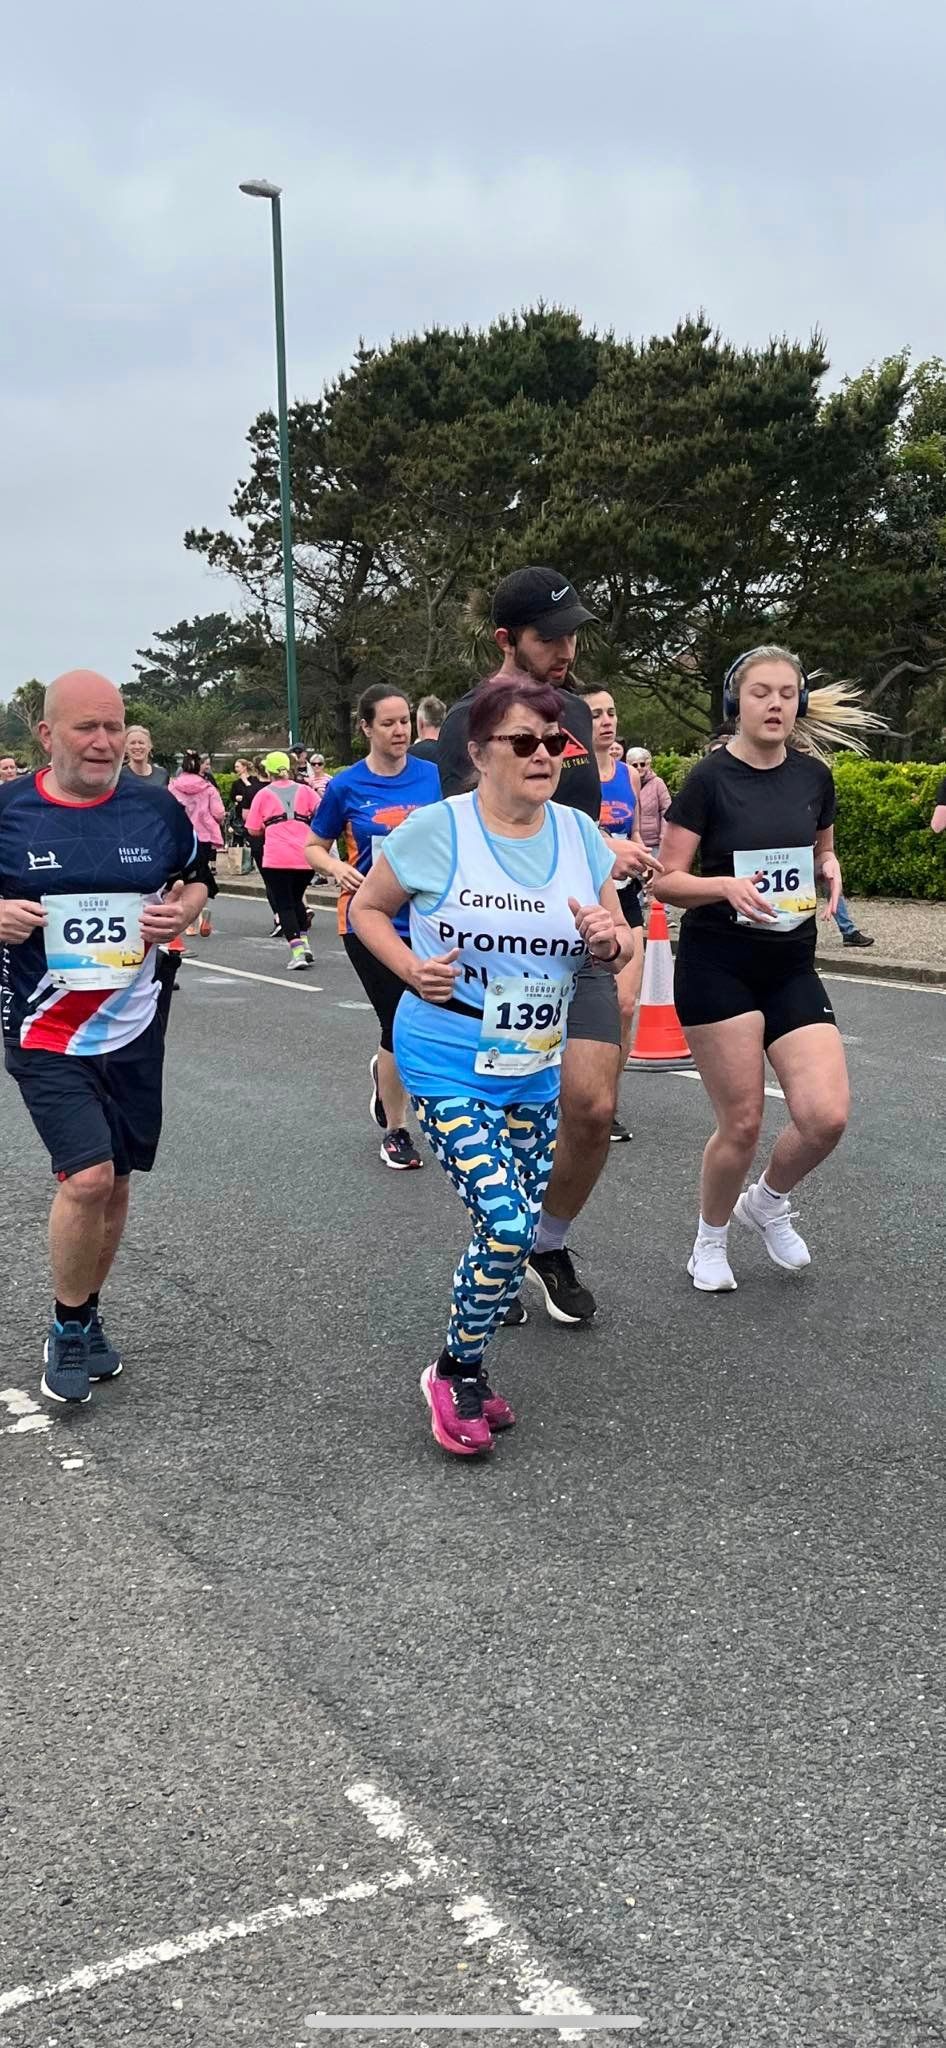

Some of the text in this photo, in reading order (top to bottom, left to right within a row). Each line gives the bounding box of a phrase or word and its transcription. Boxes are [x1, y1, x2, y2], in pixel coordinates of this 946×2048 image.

[118, 847, 150, 856] HELP for
[120, 855, 152, 864] HEROES
[755, 868, 800, 894] 516
[459, 889, 546, 913] Caroline
[63, 917, 127, 945] 625
[439, 921, 590, 957] Promena
[524, 985, 556, 993] BOGNOR
[495, 998, 563, 1031] 1398
